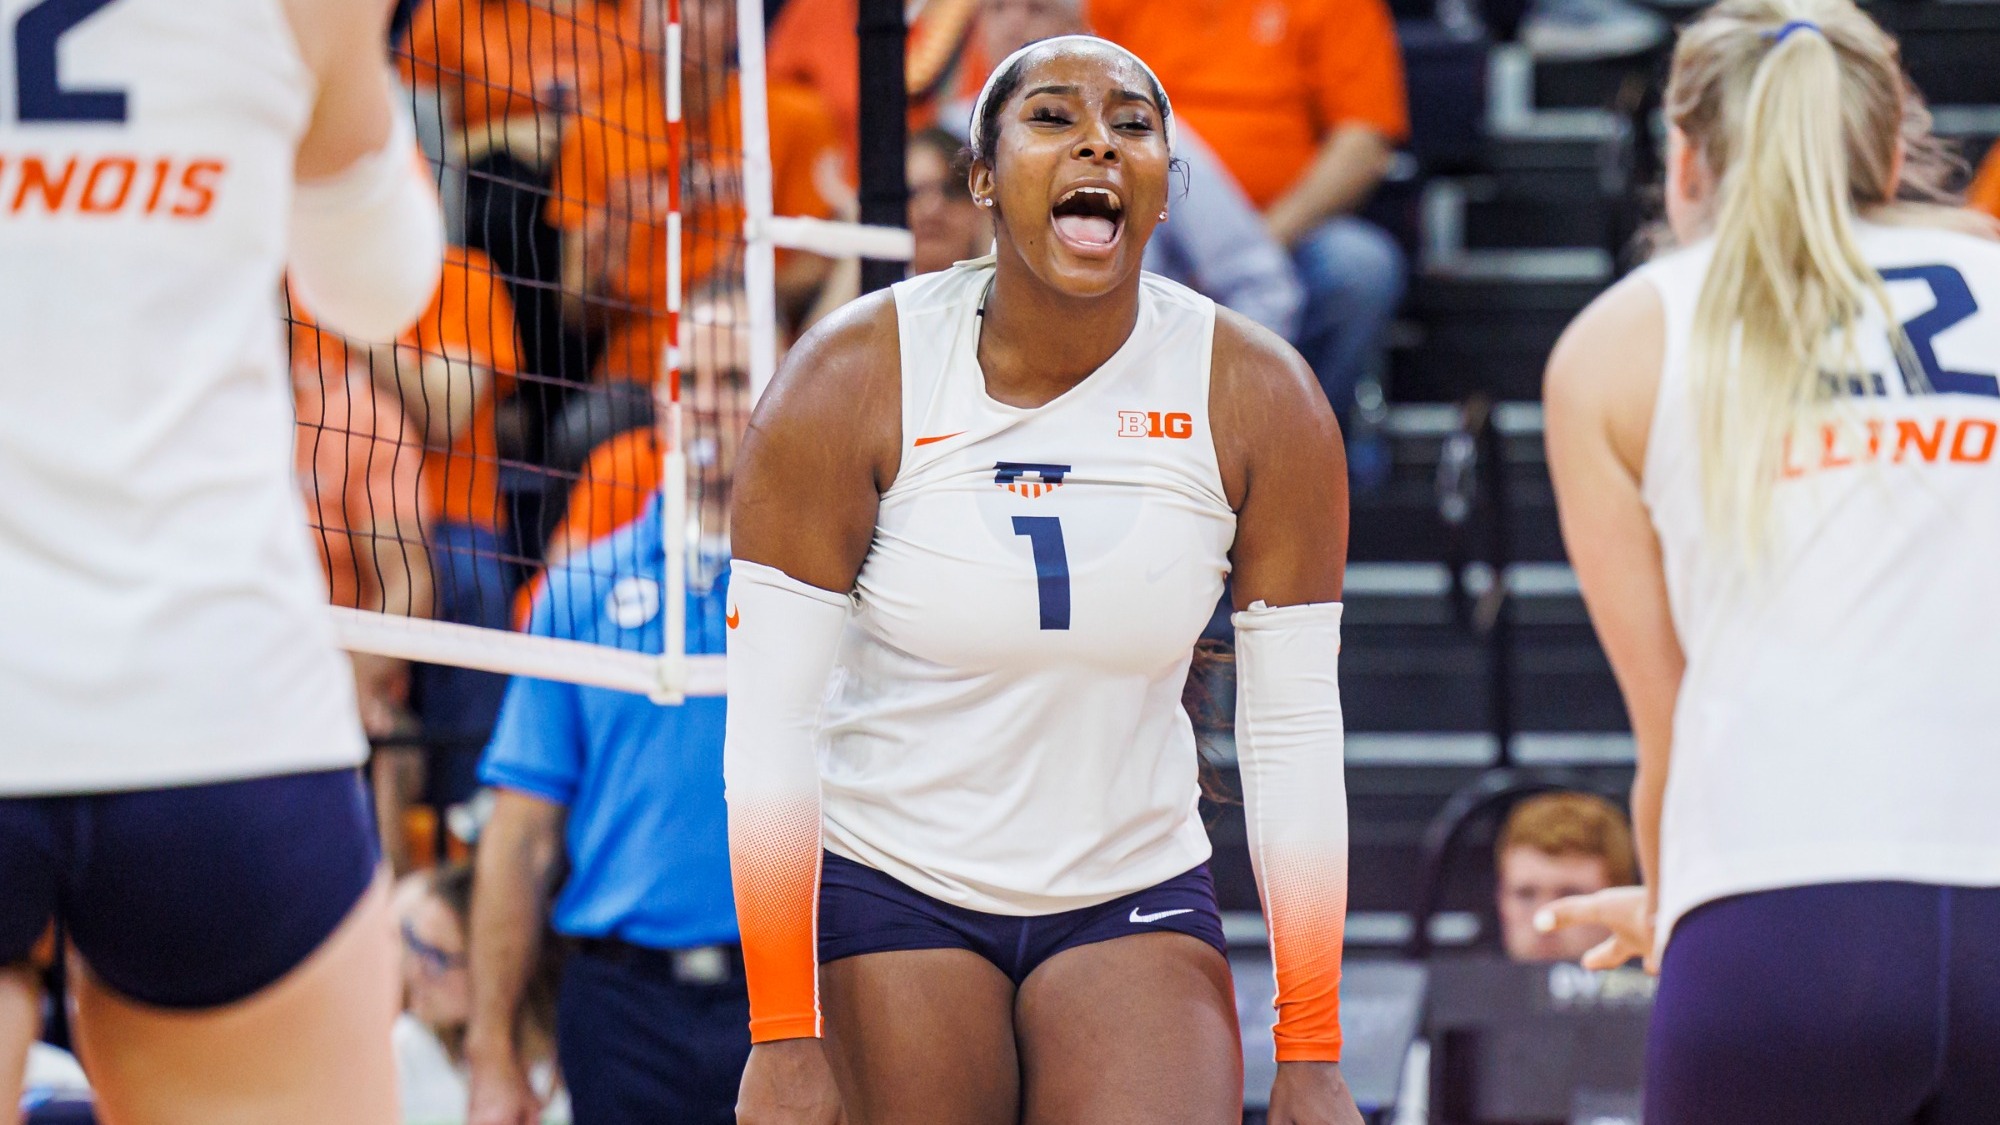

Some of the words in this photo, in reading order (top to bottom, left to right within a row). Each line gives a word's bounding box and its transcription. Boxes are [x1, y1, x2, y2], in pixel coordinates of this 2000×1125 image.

[0, 155, 225, 216] NOIS
[1775, 417, 1999, 479] LLINO
[1011, 516, 1071, 630] 1
